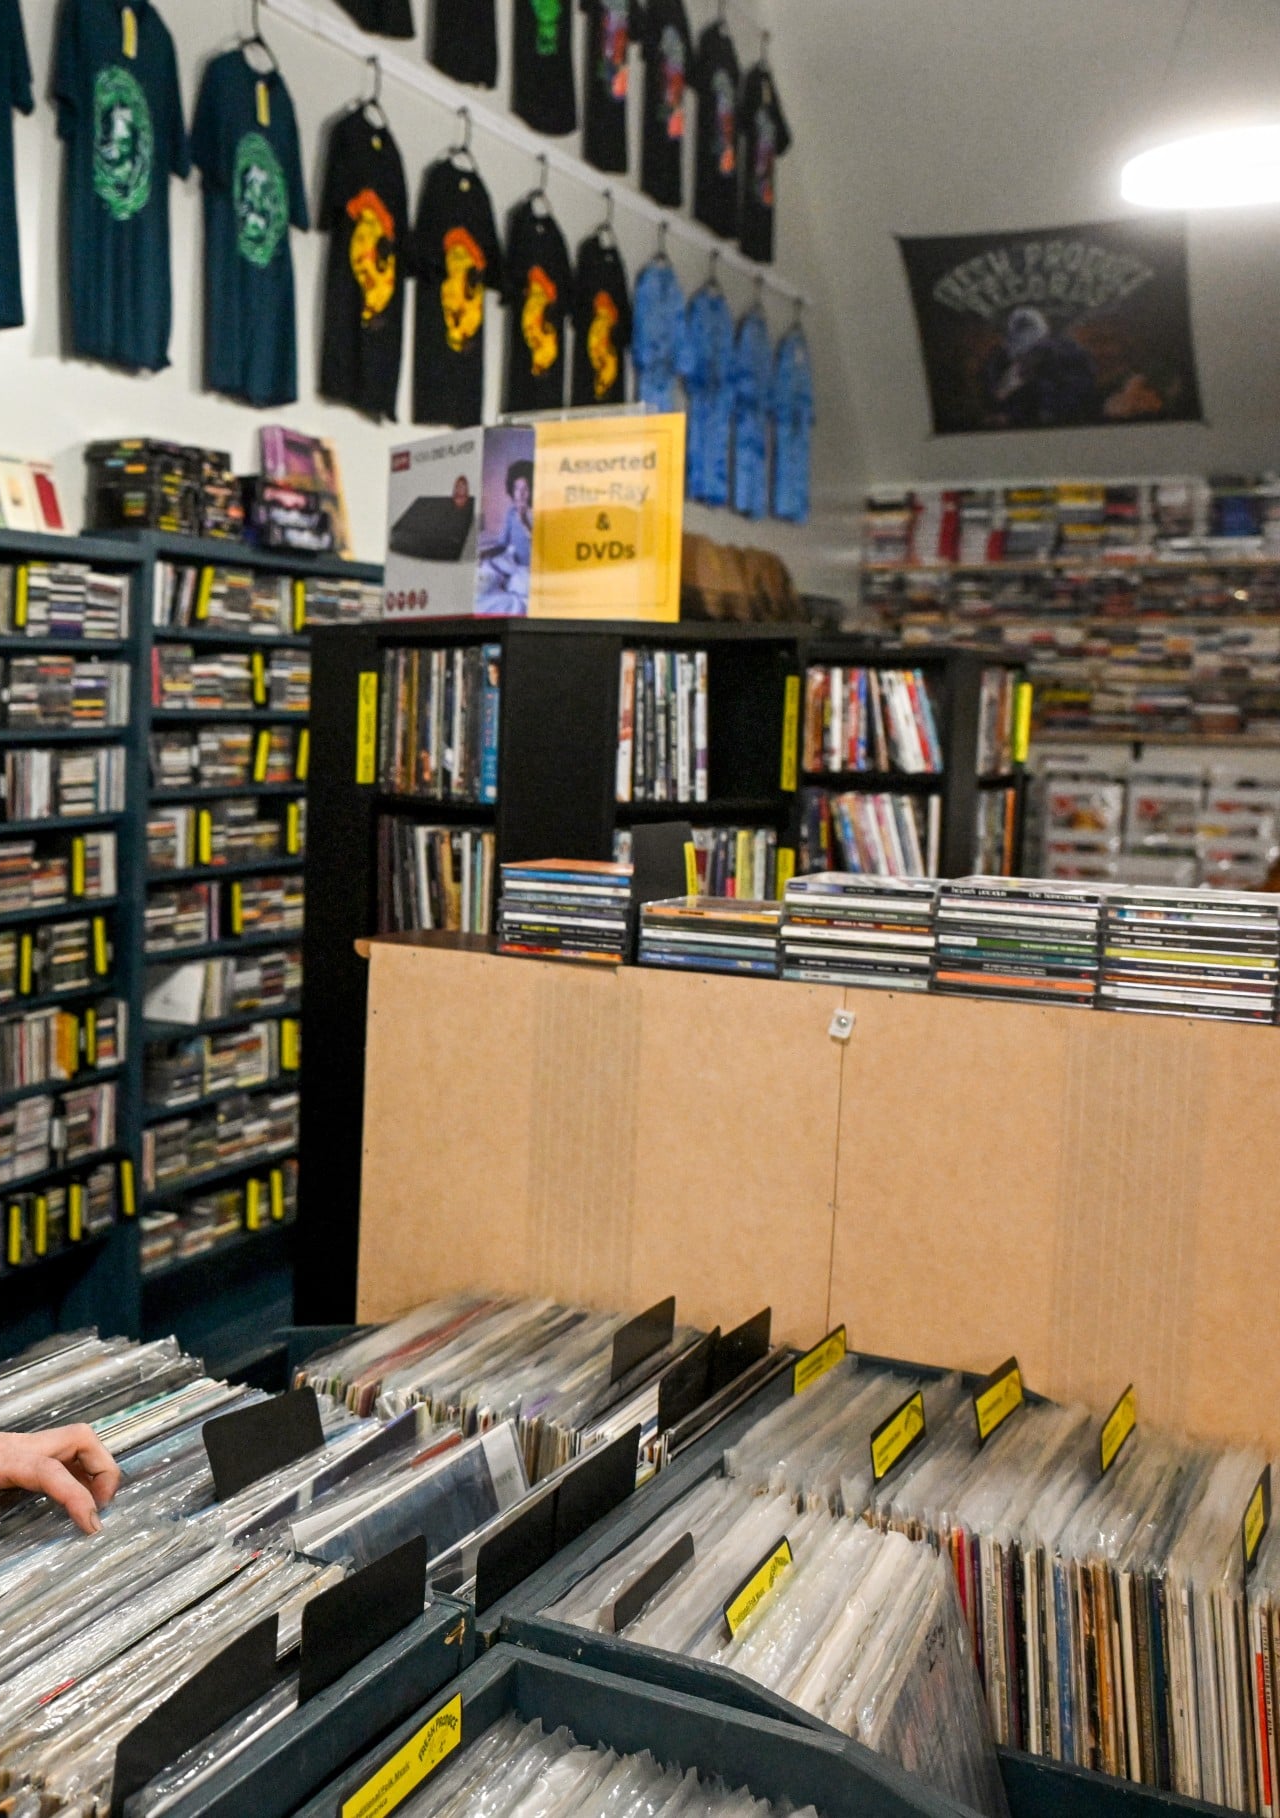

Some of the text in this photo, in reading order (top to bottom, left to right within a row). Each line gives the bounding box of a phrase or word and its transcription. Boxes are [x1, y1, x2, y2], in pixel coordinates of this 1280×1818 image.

[559, 450, 657, 474] Assorted
[564, 482, 650, 506] Blu-Ray
[596, 511, 610, 531] &
[575, 541, 636, 561] DVDs
[418, 1713, 459, 1762] FRESH PRODUCE
